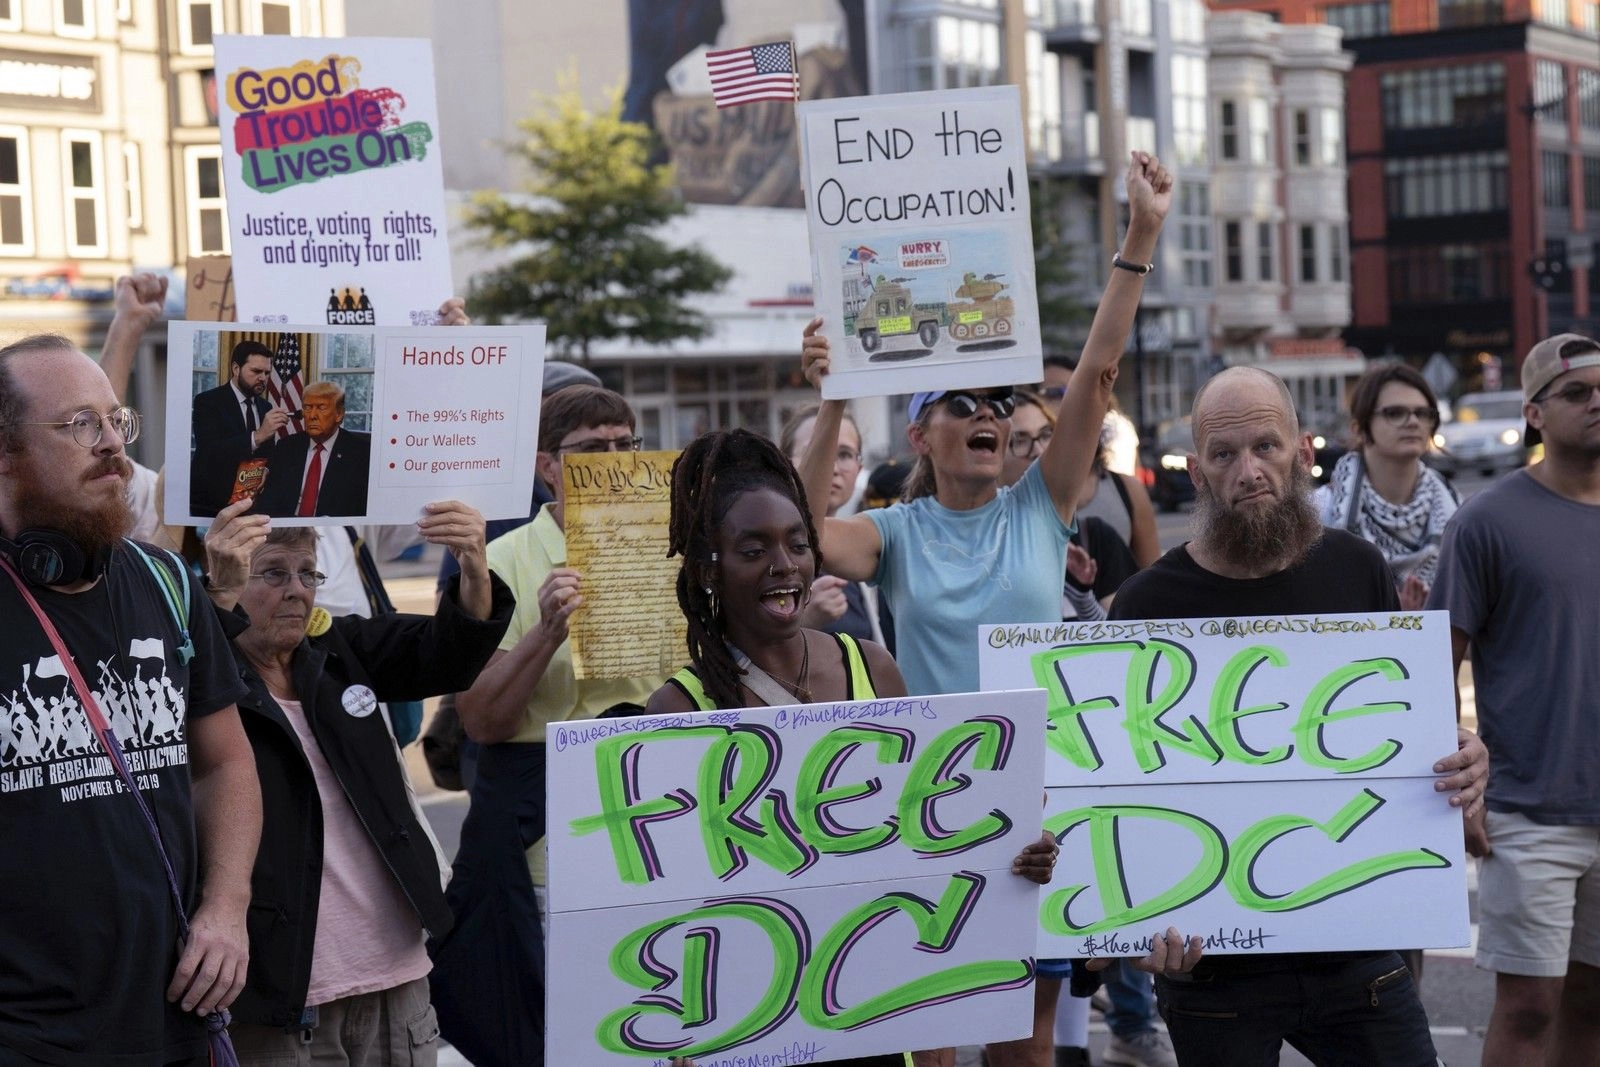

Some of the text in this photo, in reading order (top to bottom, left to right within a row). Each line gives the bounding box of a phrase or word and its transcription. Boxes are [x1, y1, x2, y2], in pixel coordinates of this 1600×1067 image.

[235, 58, 341, 110] Good
[239, 92, 383, 148] Trouble
[834, 117, 914, 164] END
[935, 110, 1002, 156] the
[249, 129, 412, 187] Lives On
[817, 166, 1015, 226] OCCUPATION!
[242, 210, 437, 240] Justice, voting rights,
[263, 237, 422, 268] and dignity for all!
[901, 241, 941, 255] HURRY
[328, 310, 374, 324] FORCE
[402, 345, 508, 366] Hands OFF
[406, 410, 430, 422] The
[470, 409, 505, 424] Rights
[405, 433, 476, 447] Our Wallets
[404, 457, 501, 473] Our government
[567, 462, 604, 489] We
[1031, 638, 1412, 774] FREE
[1, 766, 44, 793] SLAVE
[49, 756, 115, 785] REBELLION
[60, 773, 160, 803] NOVEMBER 8- 2019
[569, 715, 1015, 885] FREE
[1039, 788, 1452, 936] DC
[595, 870, 1036, 1060] DC
